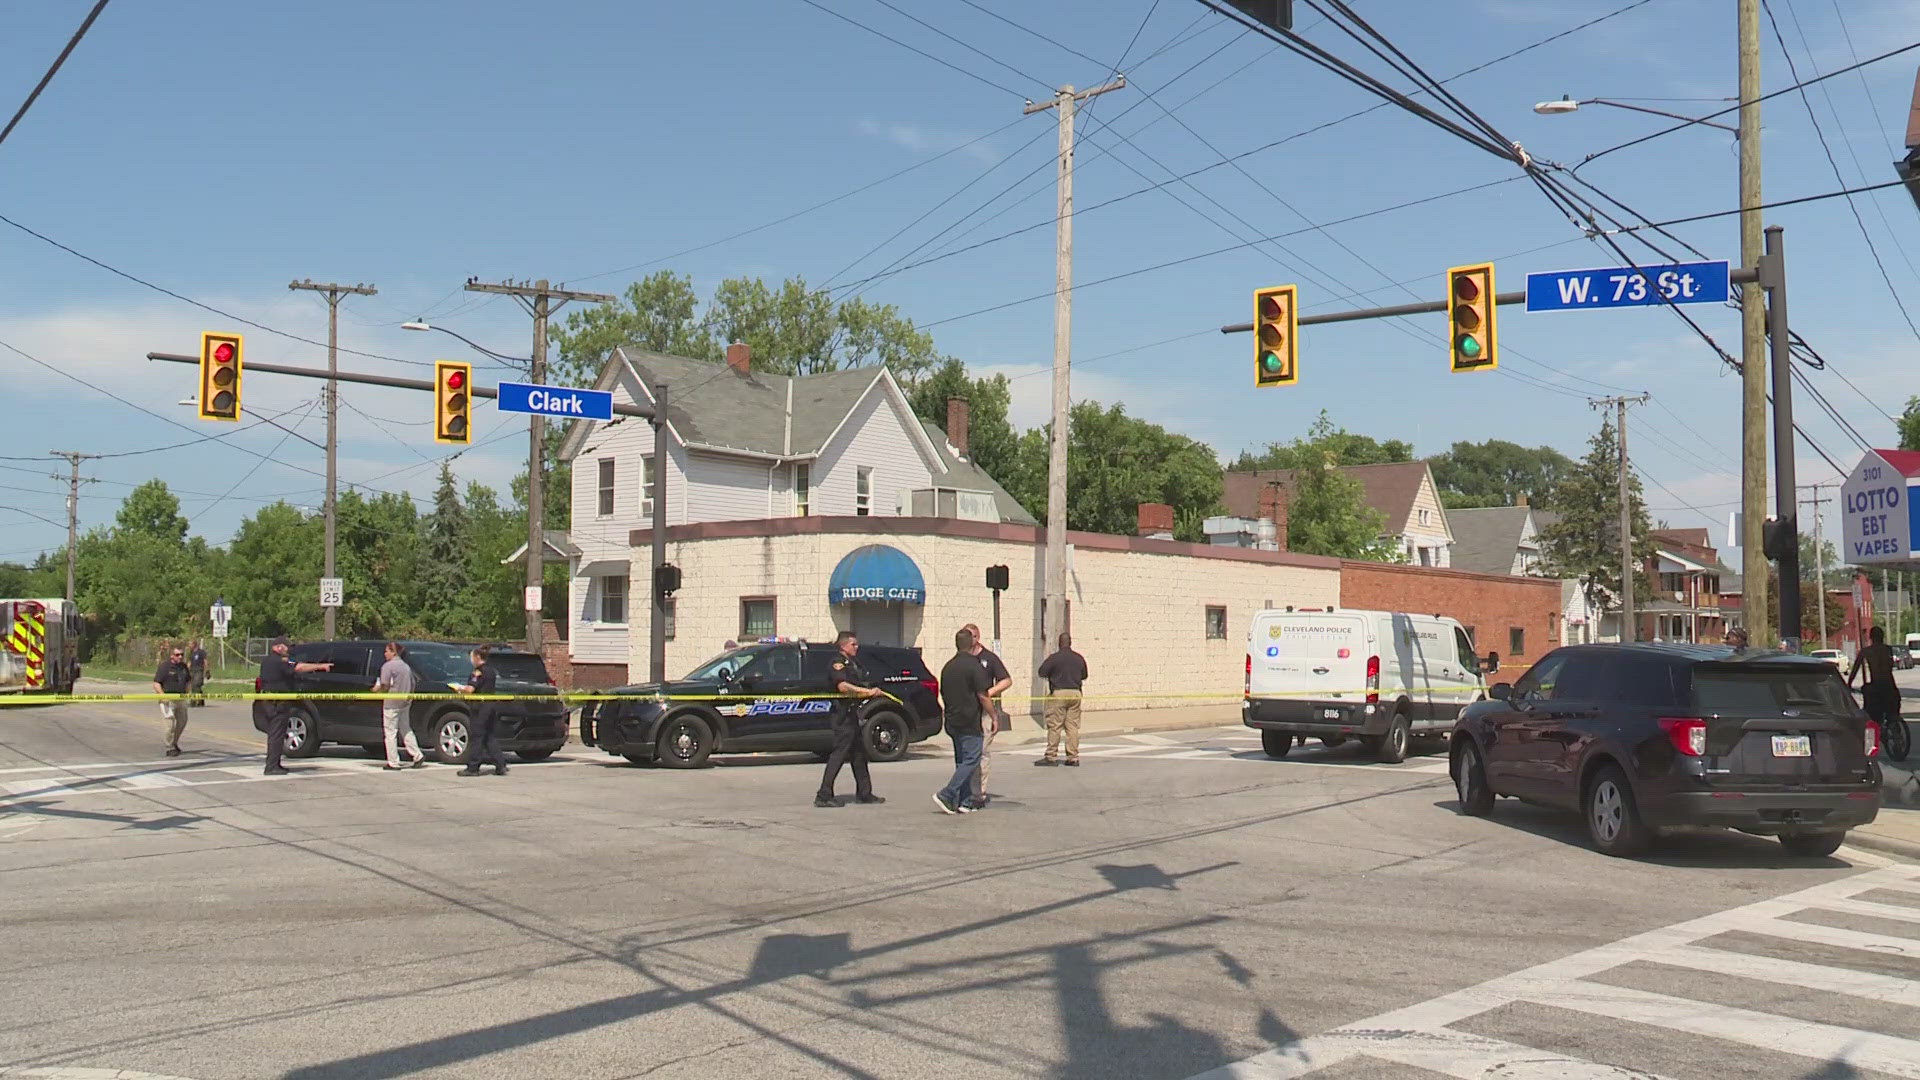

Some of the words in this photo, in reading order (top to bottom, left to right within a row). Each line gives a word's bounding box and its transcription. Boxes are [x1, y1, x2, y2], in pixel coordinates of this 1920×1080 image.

[1557, 276, 1599, 304] W.
[1609, 274, 1647, 301] 73
[528, 390, 583, 414] Clark
[1863, 466, 1882, 481] 3101
[1847, 486, 1900, 514] LOTTO
[1861, 514, 1888, 536] EBT
[1854, 538, 1899, 556] VAPES
[323, 592, 340, 603] 25
[842, 587, 884, 598] RIDGE
[888, 588, 919, 599] CAFE
[750, 701, 832, 715] POLIC
